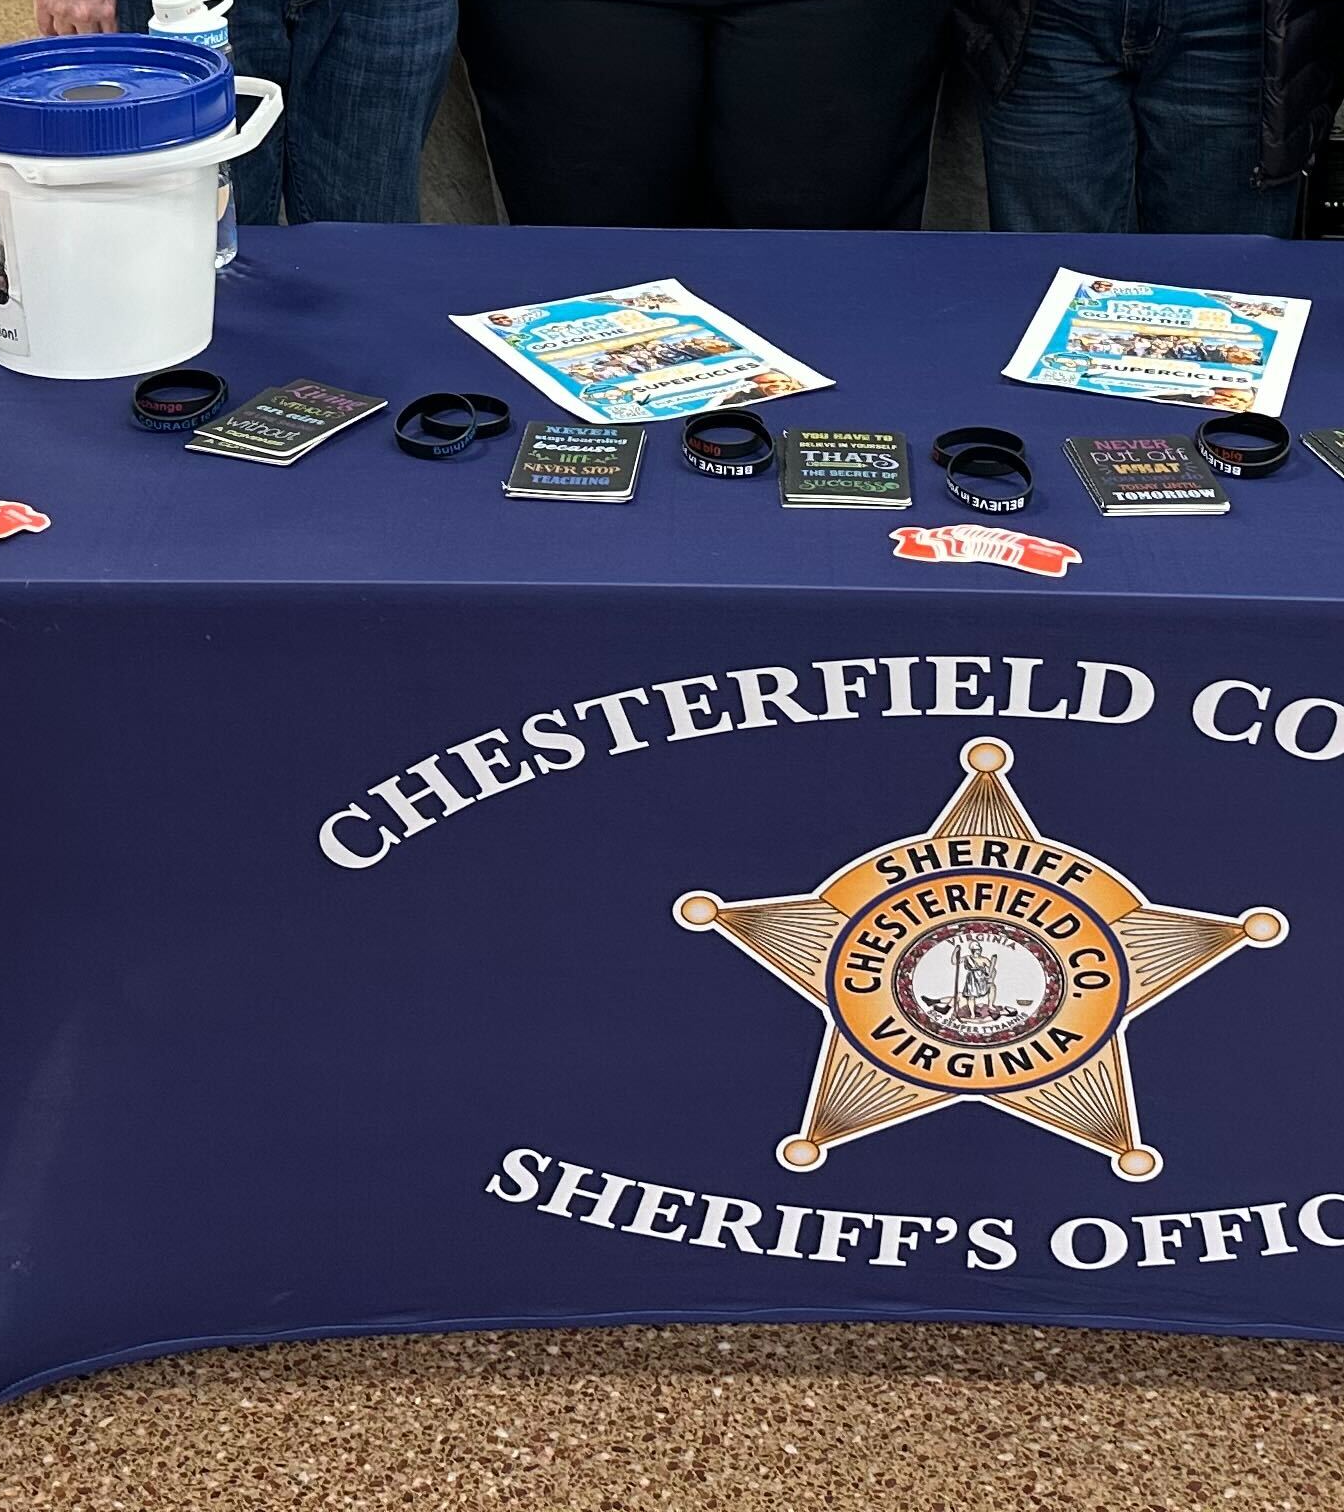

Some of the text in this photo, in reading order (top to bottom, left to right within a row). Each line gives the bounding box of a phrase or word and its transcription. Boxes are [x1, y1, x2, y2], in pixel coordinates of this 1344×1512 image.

[1082, 310, 1192, 327] GO FOR THE
[562, 326, 629, 346] FOR THE
[632, 360, 762, 394] SUPERCICLES
[1099, 363, 1250, 384] SUPERCICLES
[544, 425, 619, 437] NEVER
[801, 432, 894, 442] YOU HAVE TO
[532, 439, 618, 454] because
[566, 435, 629, 446] learning
[799, 441, 837, 449] BELIEVE
[1093, 439, 1170, 451] NEVER
[1092, 446, 1192, 465] put off
[522, 462, 622, 476] NEVER STOP
[698, 458, 754, 476] BELIEVE
[801, 469, 825, 477] THE
[829, 470, 878, 478] SECRET
[1112, 461, 1182, 476] WHAT
[531, 474, 611, 486] TEACHING
[1112, 487, 1217, 502] TOMORROW
[972, 496, 1026, 514] BELIEVE
[315, 655, 1158, 871] CHESTERFIELD
[875, 839, 1093, 886] SHERIFF
[845, 882, 1112, 999] CHESTERFIELD CO.
[947, 932, 1017, 951] VIRGINIA
[941, 1011, 1030, 1034] SEMPER TYRANNIS
[870, 1014, 1085, 1079] VIRGINIA
[485, 1147, 1018, 1272] SHERIFF'S
